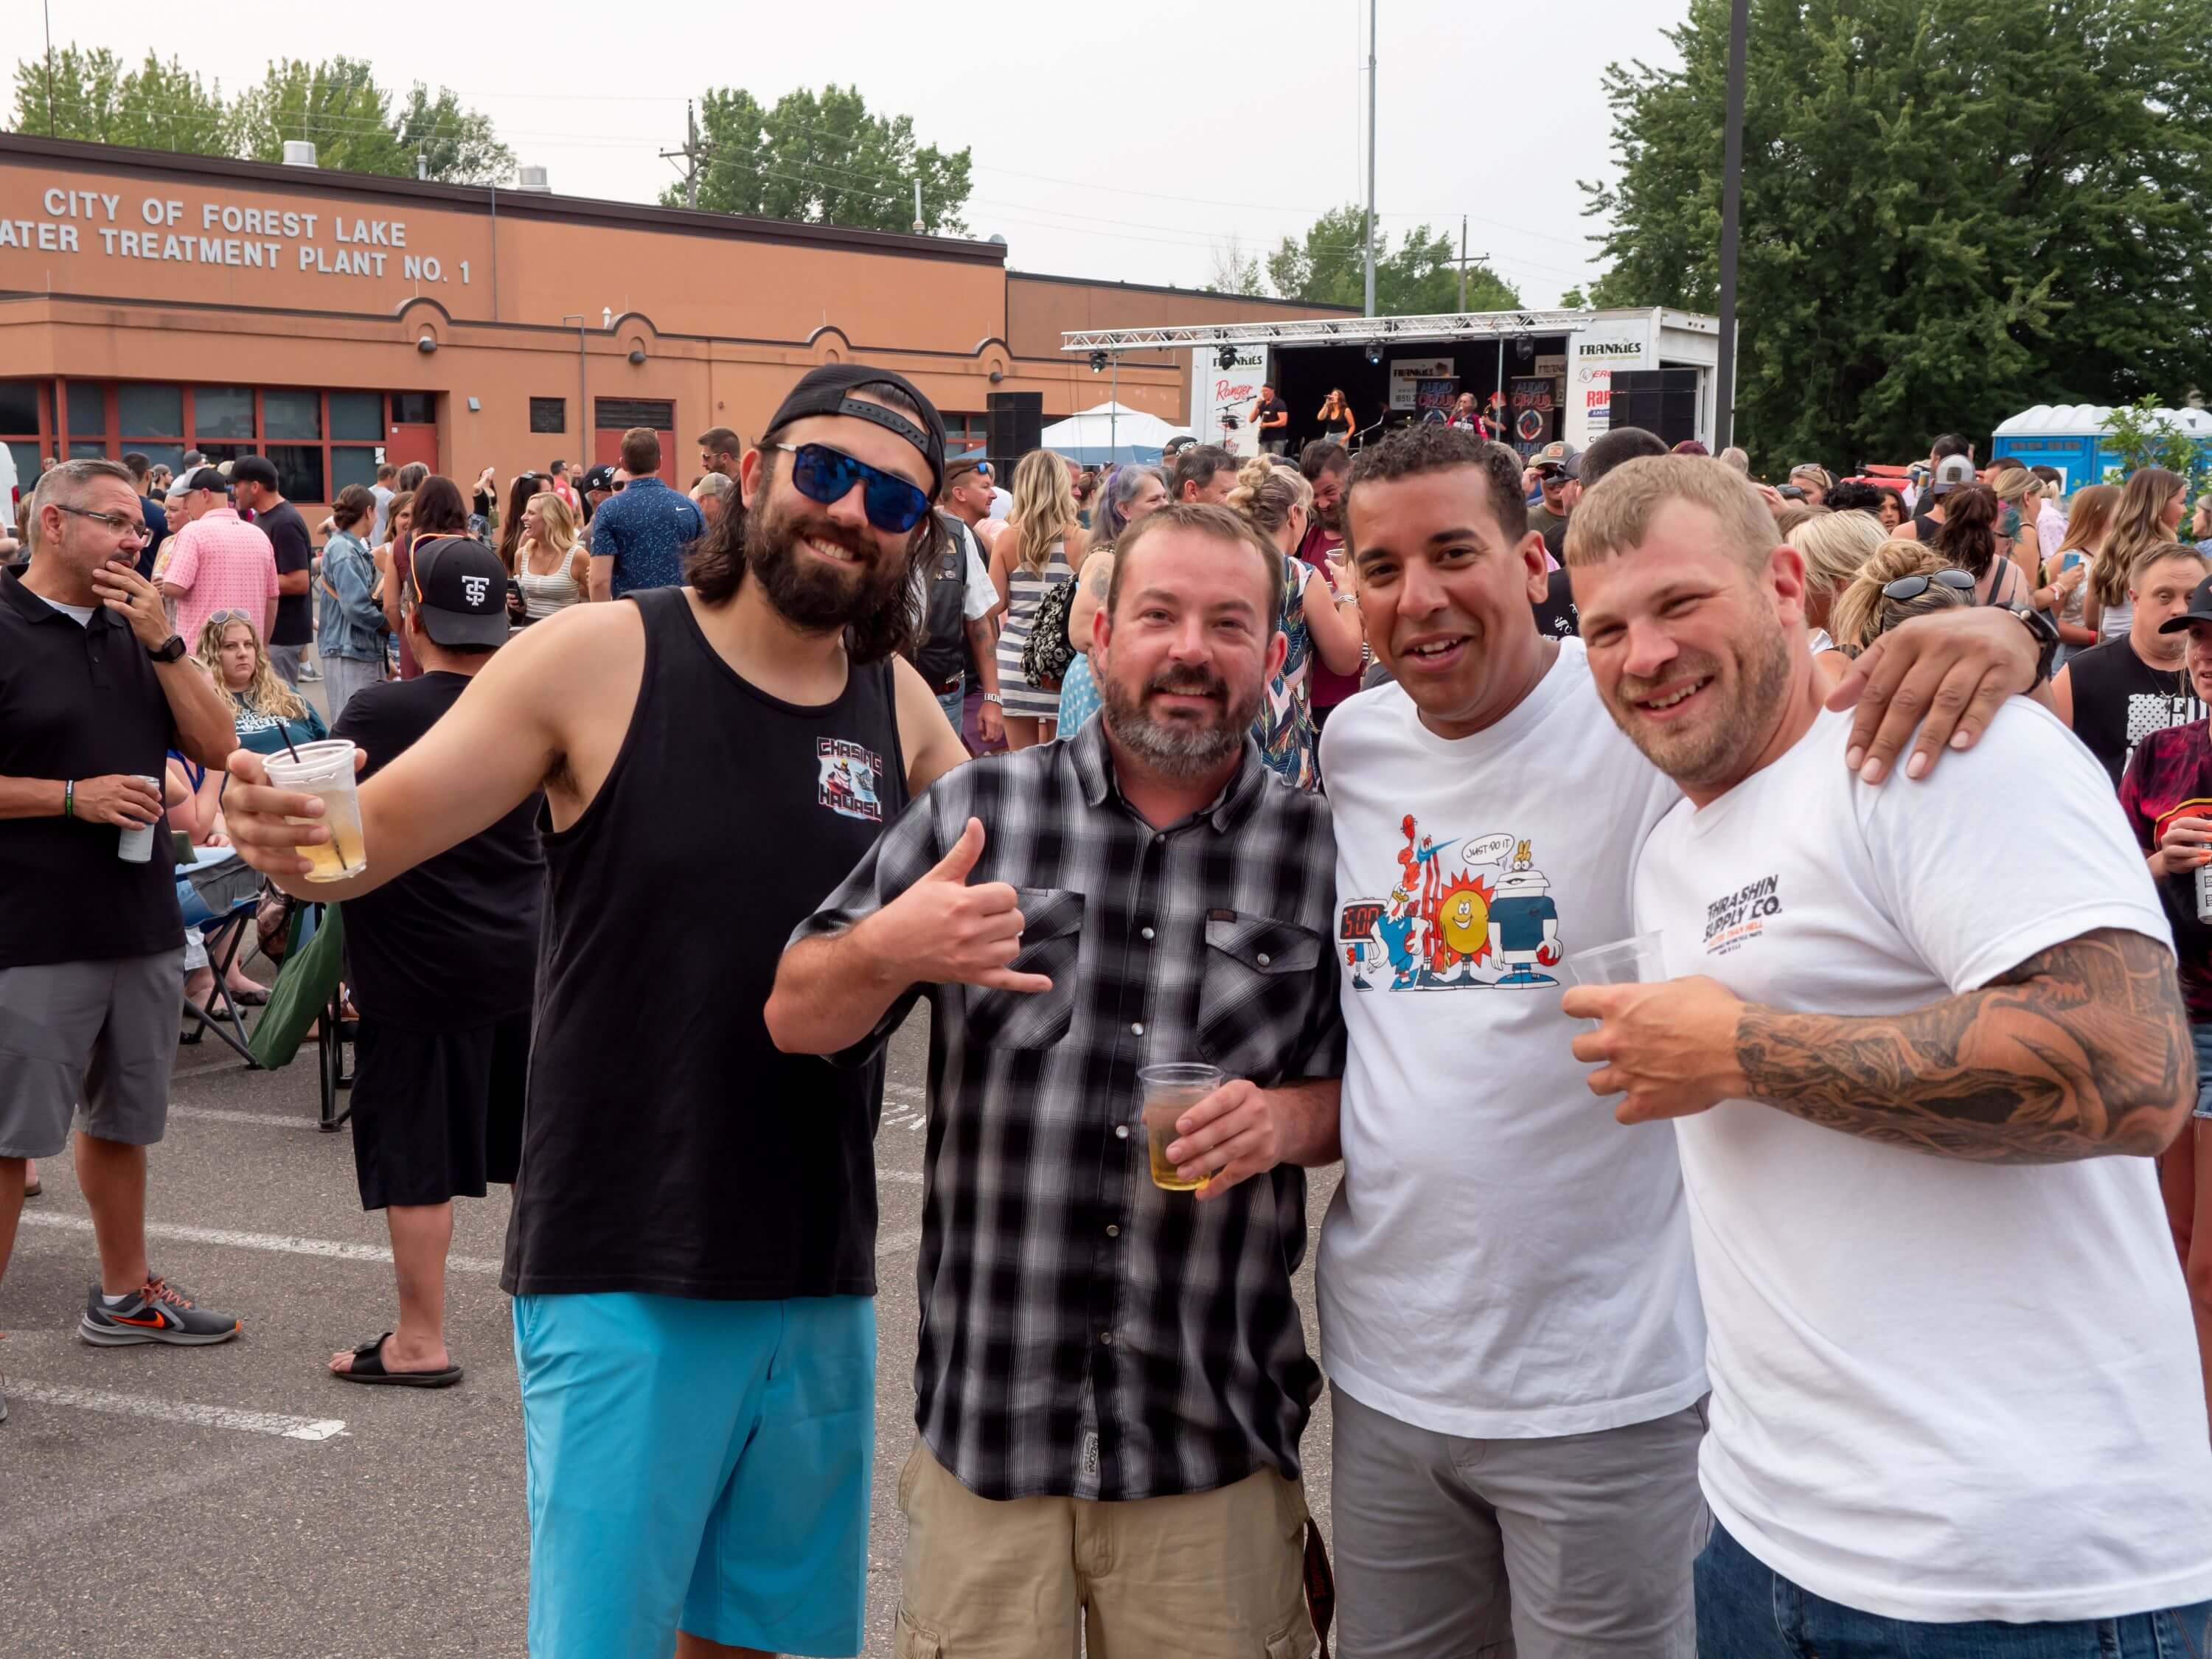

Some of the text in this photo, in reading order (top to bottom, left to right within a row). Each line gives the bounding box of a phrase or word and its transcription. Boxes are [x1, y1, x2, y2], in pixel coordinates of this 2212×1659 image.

[44, 187, 406, 248] CITY OF FOREST LAKE
[0, 219, 470, 284] ATER TREATMENT PLANT NO. 1
[1213, 355, 1262, 367] FNKIES
[1215, 380, 1253, 400] Ranger
[817, 737, 883, 777] CHASING
[1467, 838, 1510, 858] JUST DO IT
[1707, 874, 1778, 922] THRASHIN
[1703, 905, 1747, 943] SUPPLY
